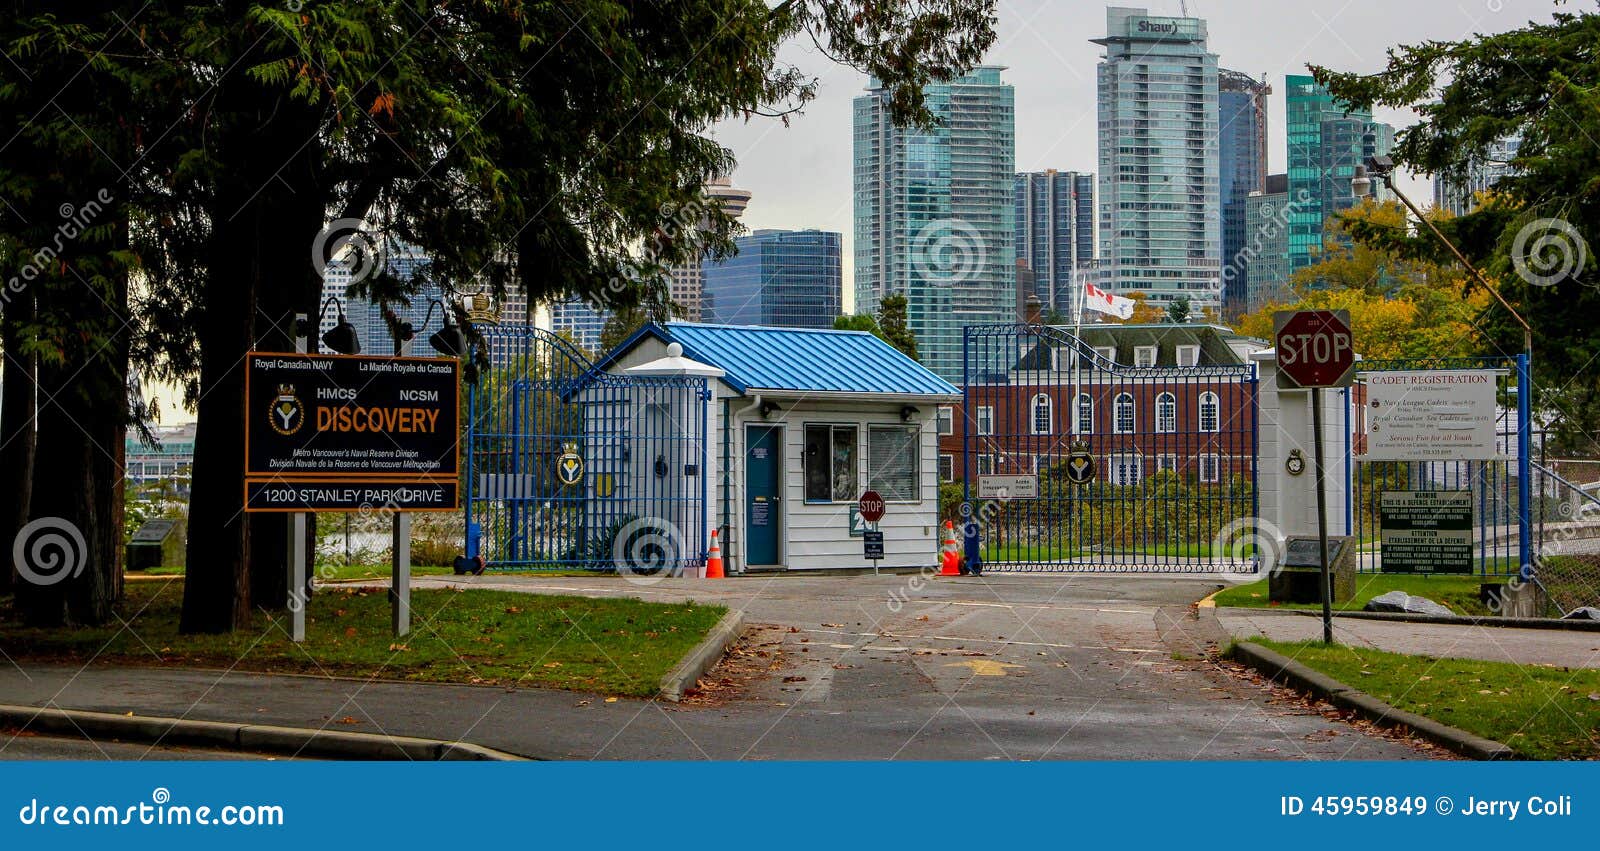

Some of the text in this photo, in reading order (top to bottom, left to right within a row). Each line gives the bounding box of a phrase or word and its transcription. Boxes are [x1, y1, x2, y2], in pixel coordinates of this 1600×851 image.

[1138, 20, 1178, 35] Shaw
[1280, 333, 1350, 364] STOP
[255, 359, 333, 370] Royal Canadian NAVY
[359, 362, 452, 374] La Marine Royale du Canada
[1372, 375, 1488, 385] CADET REGISTRATION
[317, 388, 357, 400] HMCS
[399, 390, 439, 401] NCSM
[316, 406, 440, 433] DISCOVERY
[312, 449, 349, 458] Vancouver's
[350, 449, 368, 458] Naval
[369, 450, 394, 458] Reserve
[395, 450, 419, 458] Division
[269, 459, 294, 468] Division
[295, 459, 317, 468] Navale
[318, 459, 326, 468] de
[361, 459, 370, 468] de
[370, 459, 402, 468] Vancouver
[263, 489, 442, 502] 1200 STANLEY PARK DRIVE
[861, 500, 882, 512] STOP
